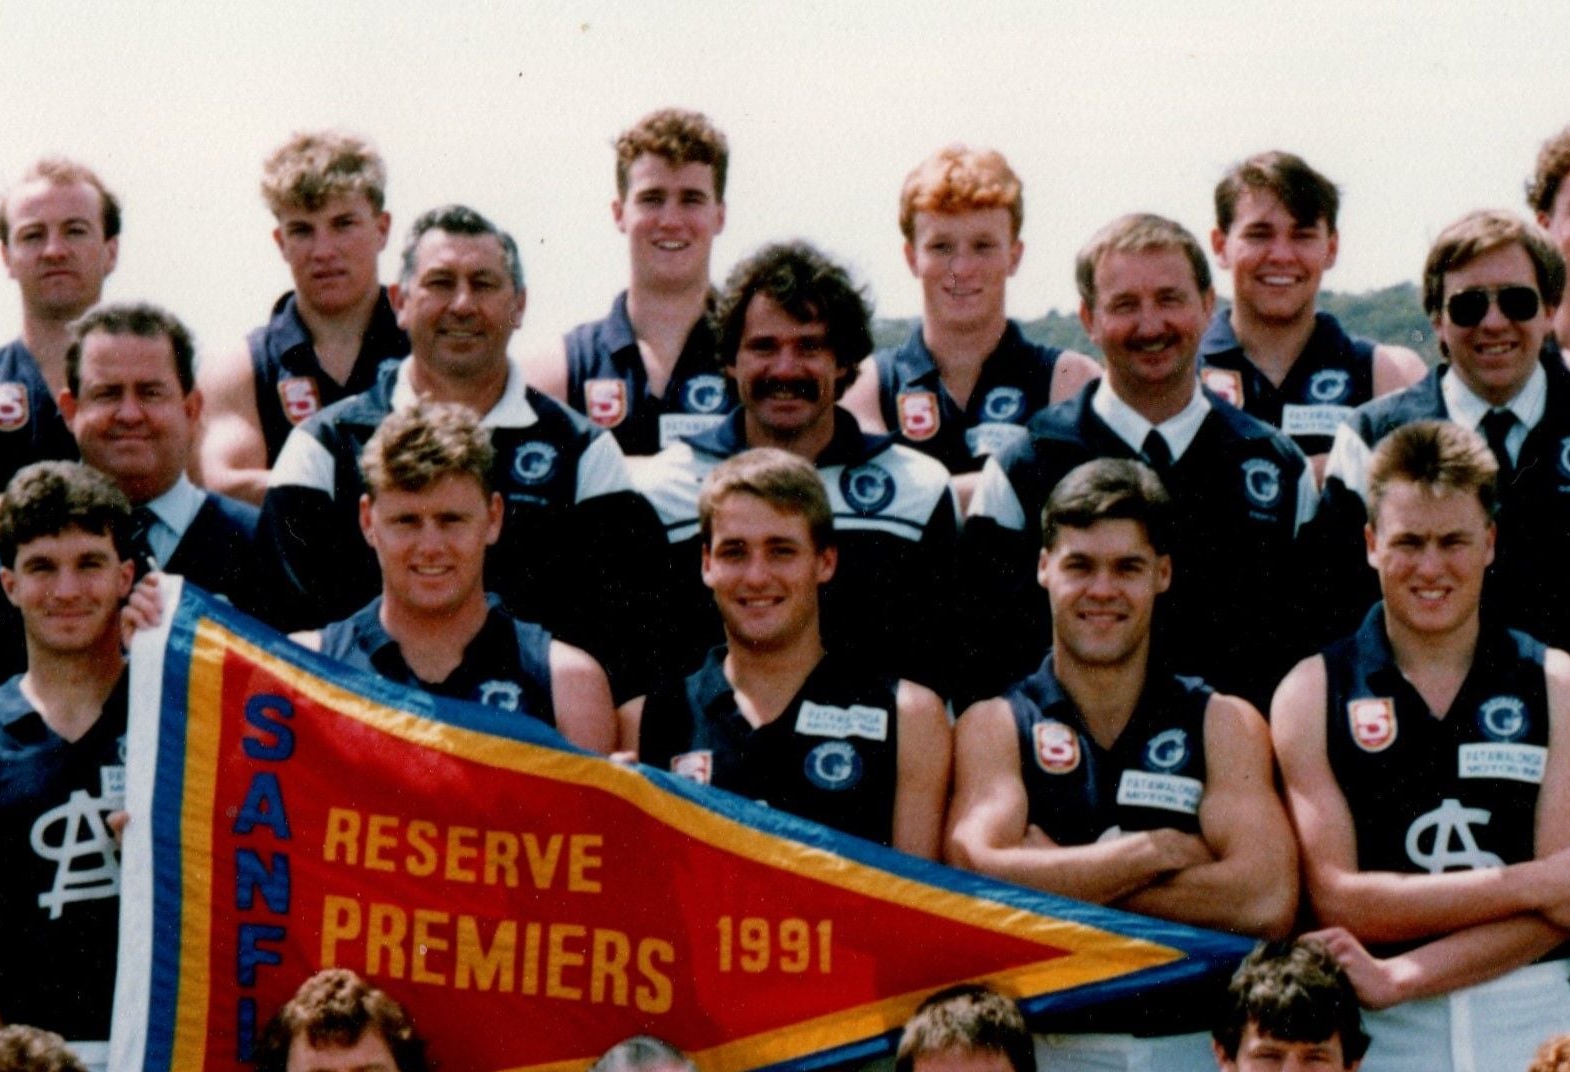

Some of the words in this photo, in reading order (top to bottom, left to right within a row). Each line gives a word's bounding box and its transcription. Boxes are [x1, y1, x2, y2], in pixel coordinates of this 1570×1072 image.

[322, 807, 604, 894] RESERVE
[319, 893, 676, 1015] PREMIERS
[718, 915, 833, 975] 1991
